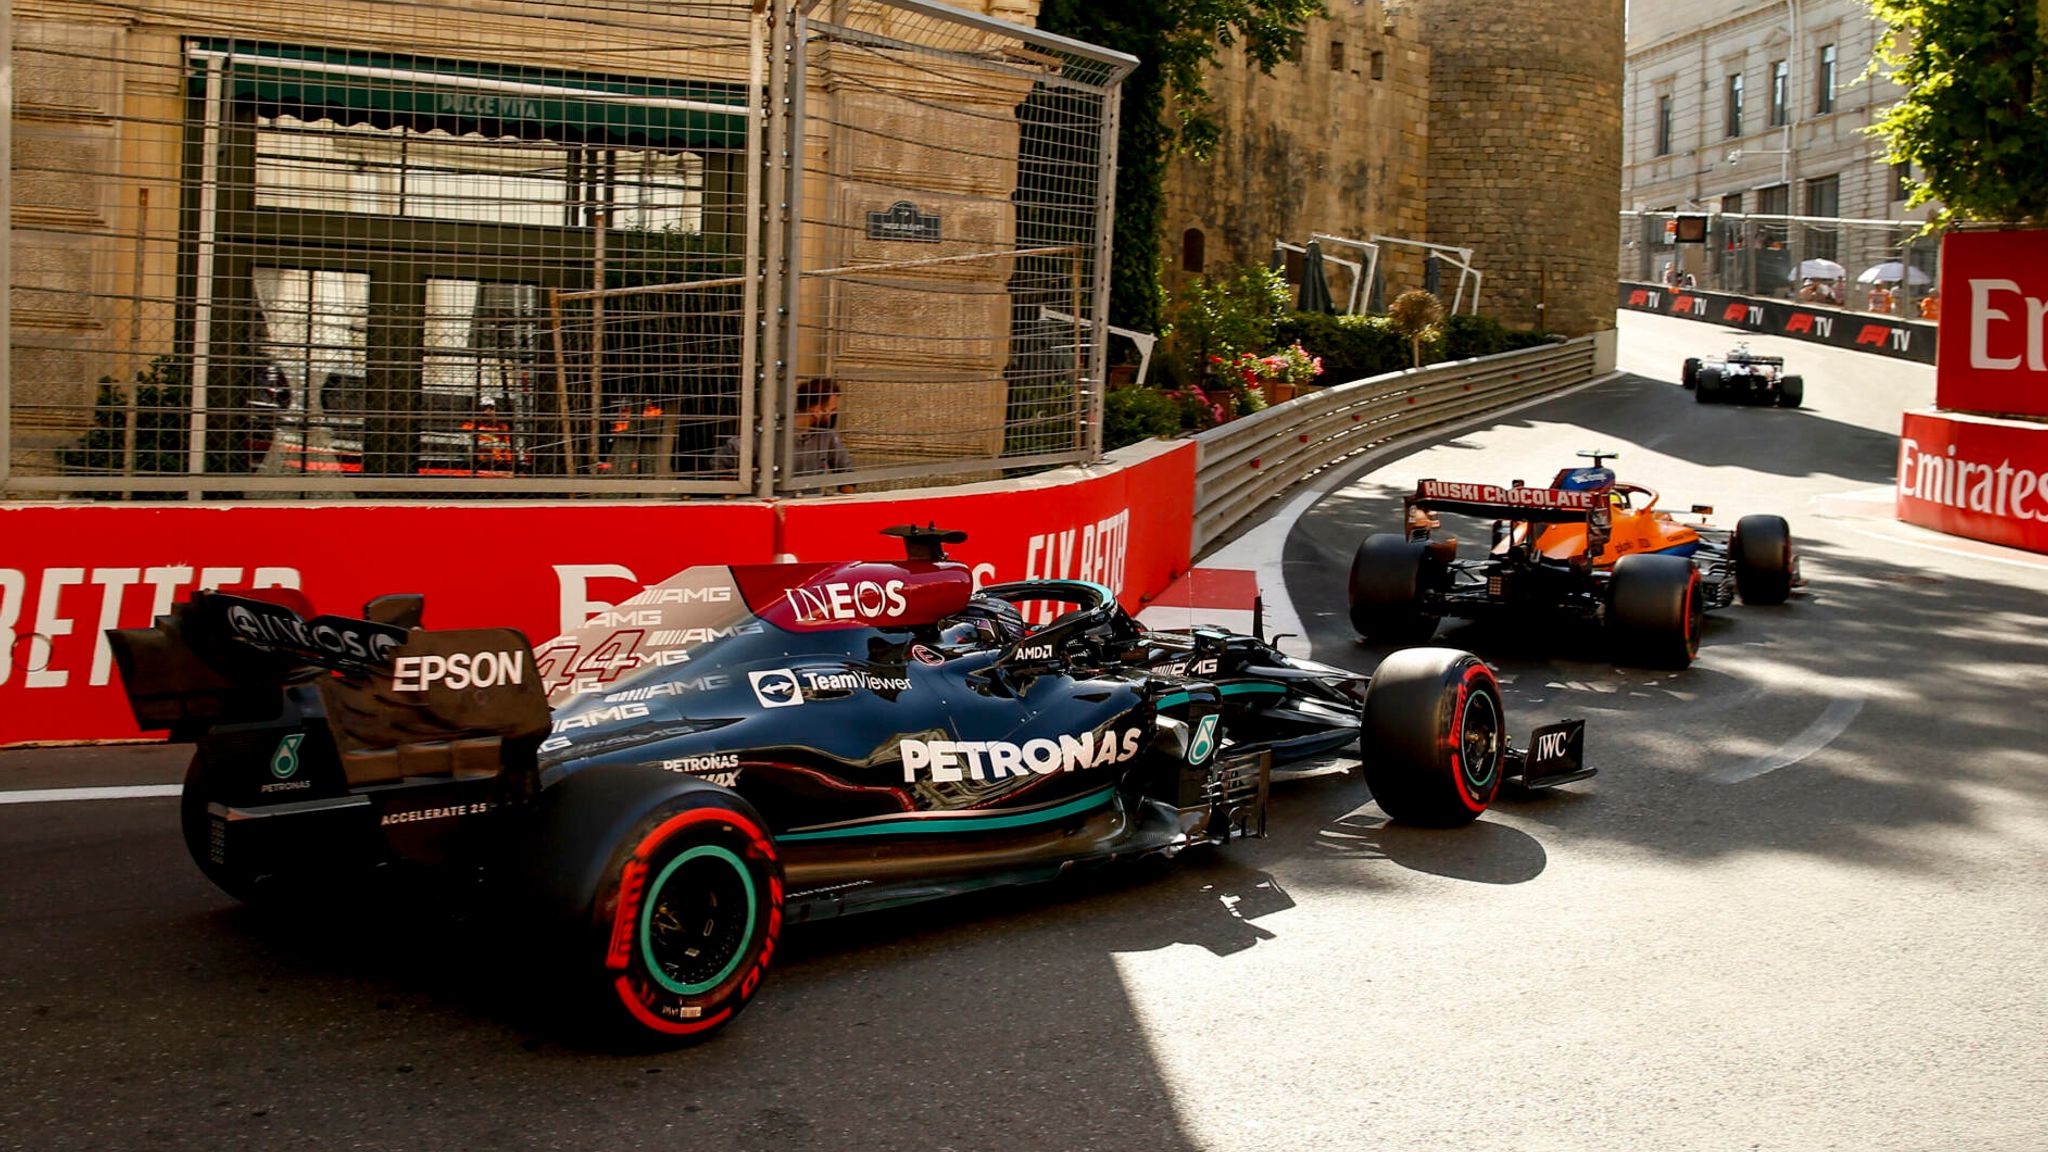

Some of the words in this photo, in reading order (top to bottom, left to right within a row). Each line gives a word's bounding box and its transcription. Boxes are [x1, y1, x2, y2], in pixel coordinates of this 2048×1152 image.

[441, 94, 496, 114] DULCE
[501, 99, 537, 118] VITA
[1648, 291, 1660, 308] TV
[1694, 297, 1708, 316] TV
[1748, 306, 1764, 325] TV
[1814, 316, 1834, 338] TV
[1891, 328, 1911, 352] TV
[1425, 481, 1479, 500] HUSKI
[1483, 486, 1593, 508] CHOCOLATE
[658, 587, 732, 605] AMG
[784, 580, 908, 622] INEOS
[583, 610, 662, 628] AMG
[261, 613, 366, 658] INEOS
[681, 622, 765, 645] AMG
[1015, 646, 1045, 661] AMD
[392, 651, 523, 692] EPSON
[803, 670, 913, 692] TeamViewer
[558, 703, 651, 734] AMG
[900, 728, 1142, 783] PETRONAS
[1536, 731, 1567, 762] IWC
[663, 754, 739, 772] PETRONAS
[261, 780, 311, 793] PETRONAS
[380, 805, 466, 826] ACCELERATE
[470, 802, 487, 814] 25
